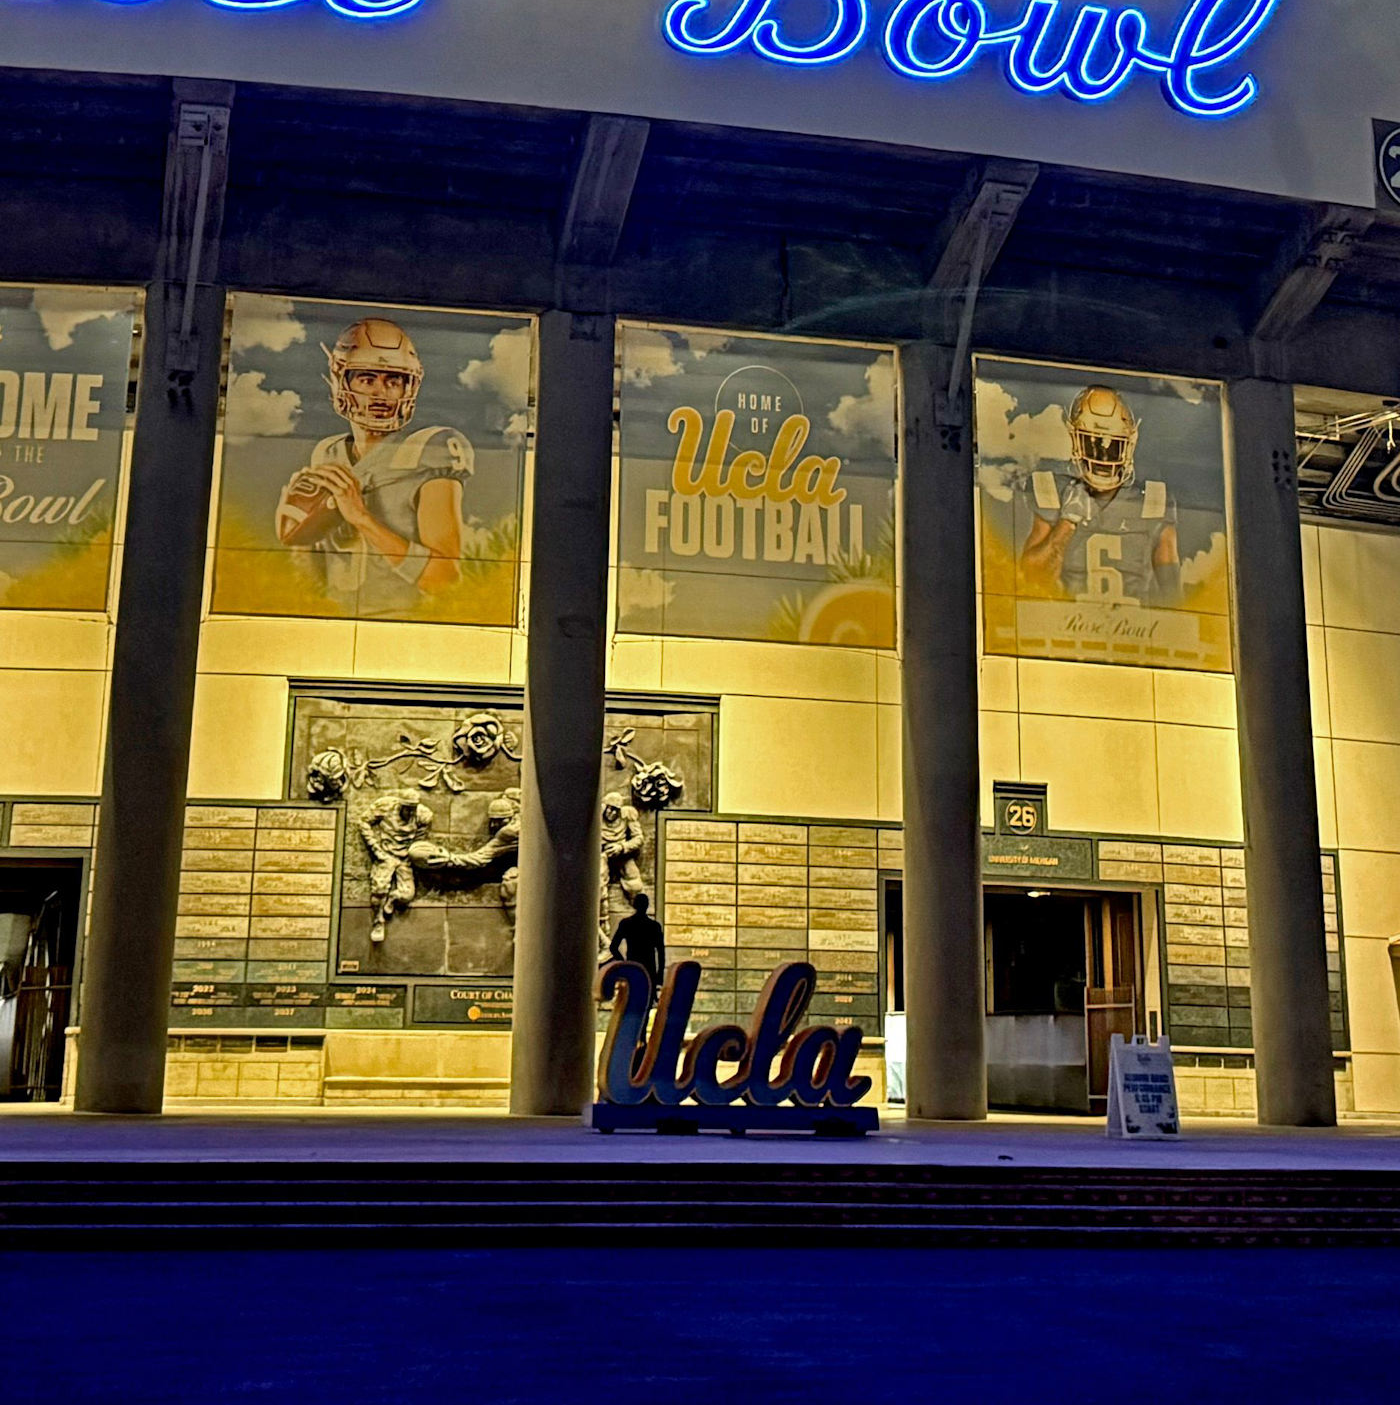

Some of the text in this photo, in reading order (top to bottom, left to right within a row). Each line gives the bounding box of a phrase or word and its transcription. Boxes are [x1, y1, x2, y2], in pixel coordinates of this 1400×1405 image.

[737, 393, 782, 412] HOME
[751, 417, 769, 434] OF
[15, 445, 44, 464] THE
[644, 489, 872, 567] FOOTBALL
[1087, 533, 1124, 600] 6
[1008, 804, 1035, 828] 26
